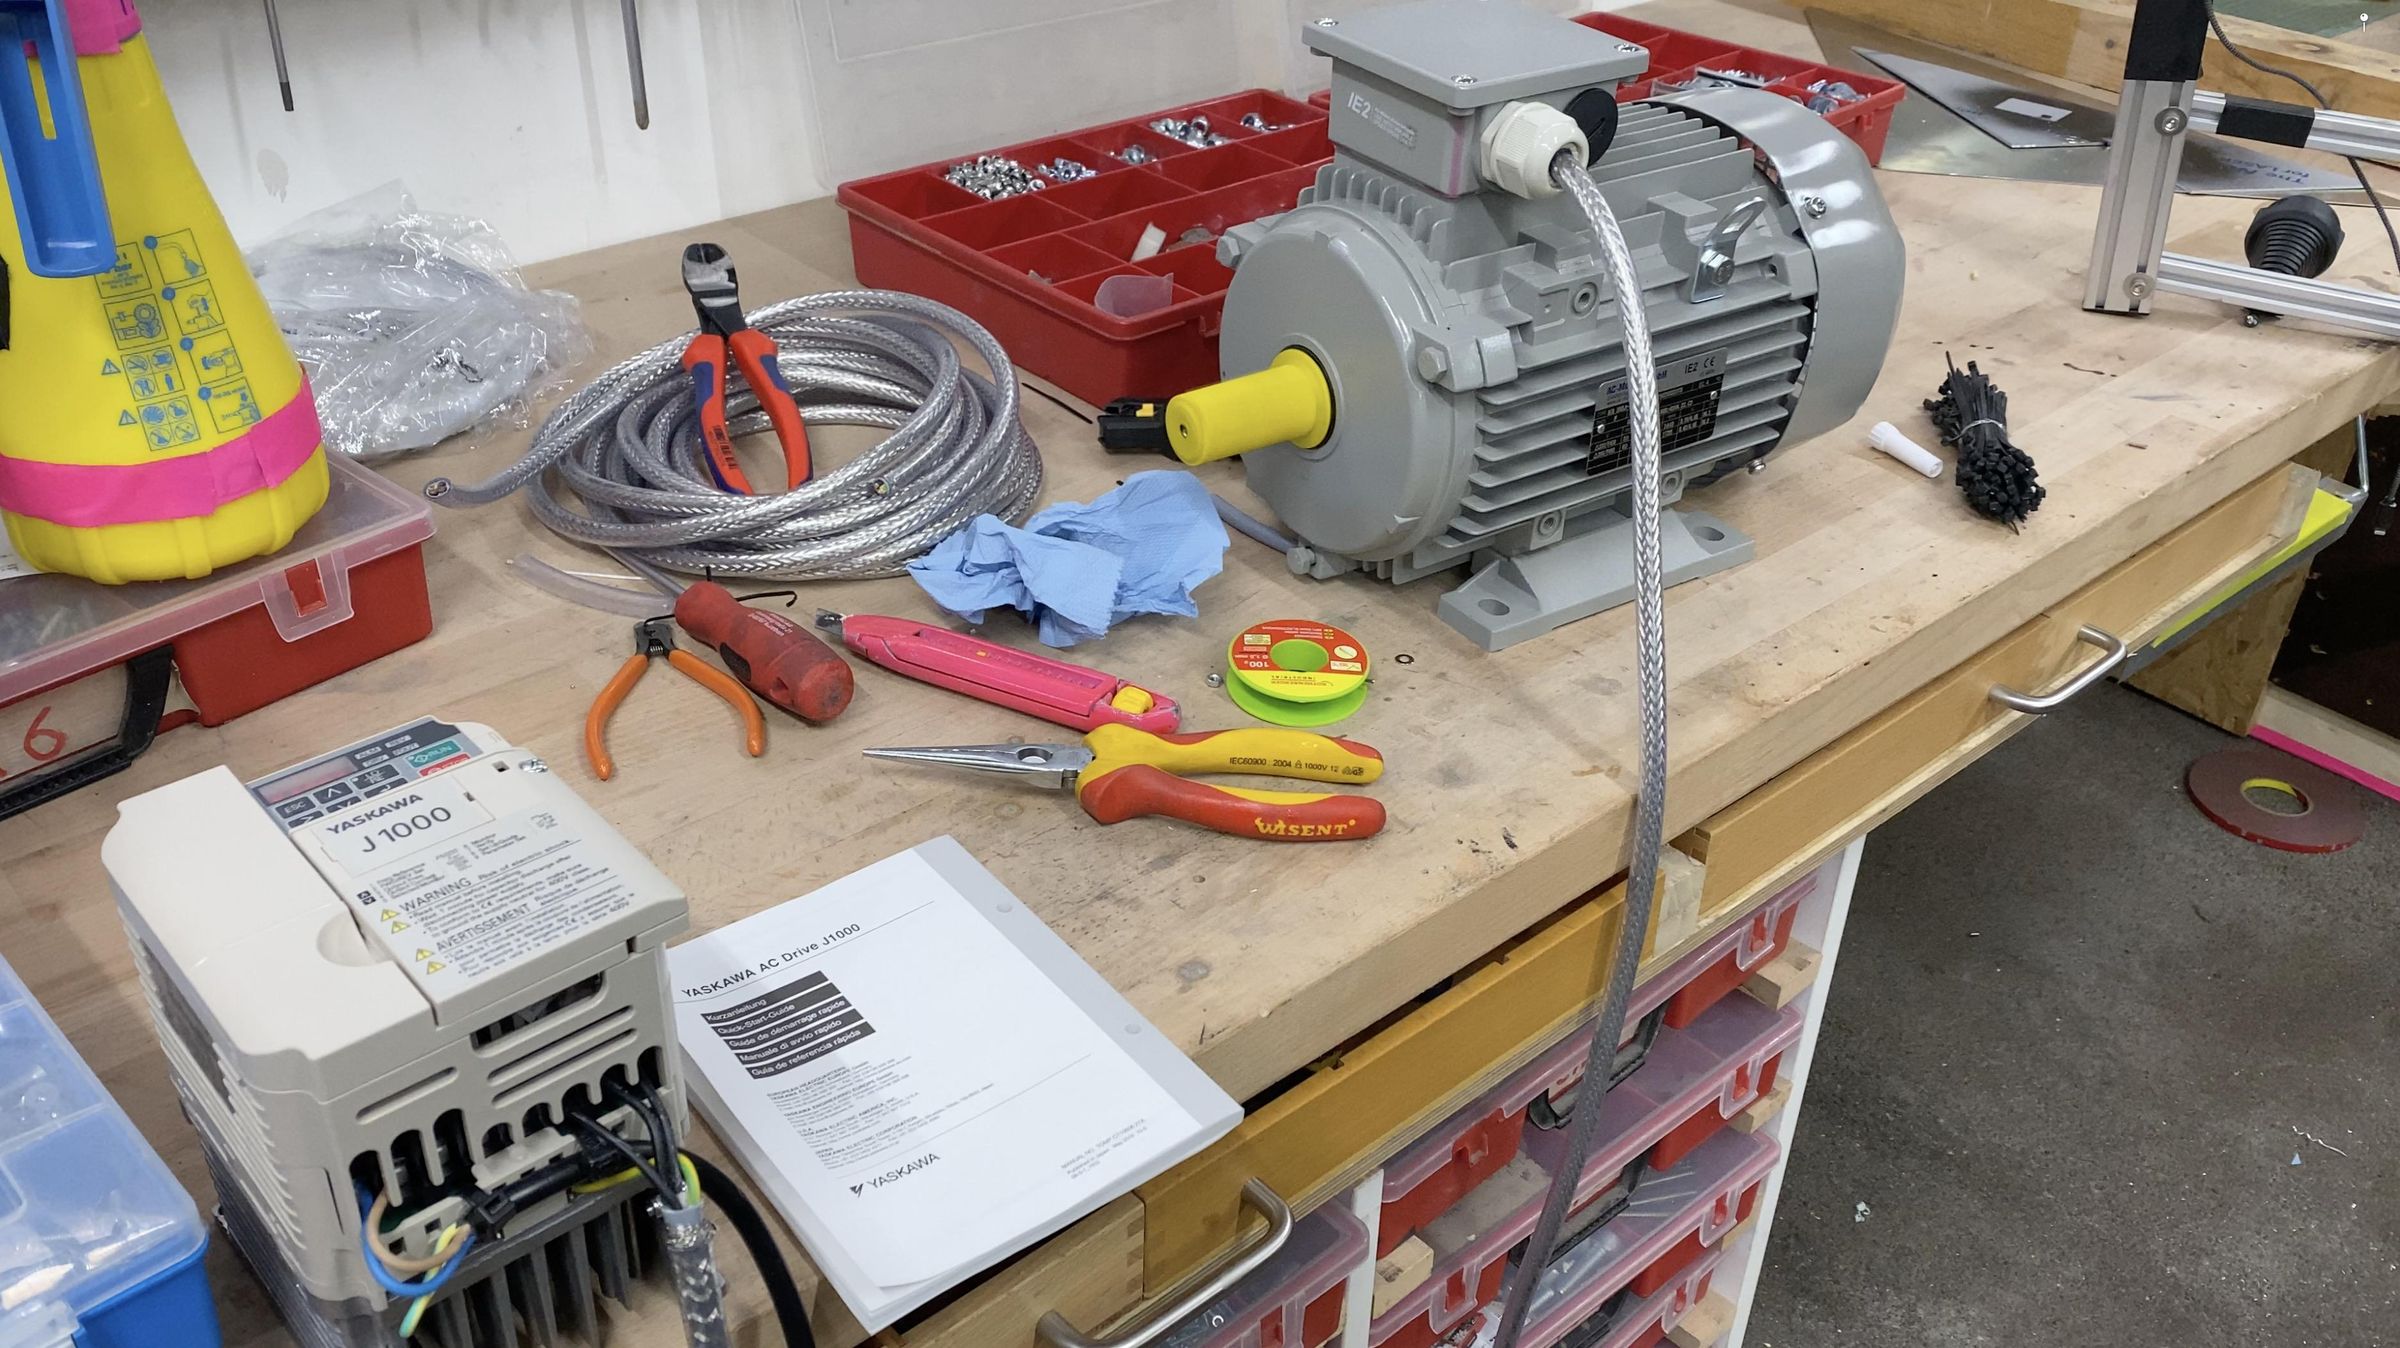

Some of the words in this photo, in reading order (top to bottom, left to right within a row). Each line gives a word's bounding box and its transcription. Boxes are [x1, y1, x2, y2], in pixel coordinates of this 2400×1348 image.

[1348, 92, 1371, 119] IE2
[1684, 362, 1699, 374] IE2
[1248, 660, 1269, 668] 100
[23, 705, 69, 762] 6
[427, 746, 453, 758] RUN
[1272, 759, 1292, 768] 2004
[1304, 762, 1328, 772] 1000V
[283, 801, 307, 814] ESC
[326, 794, 423, 835] YASKAWA
[398, 876, 473, 913] WARNING
[431, 902, 534, 951] AVERTISSEMENT
[681, 968, 756, 998] YASKAWA
[758, 957, 780, 973] AC
[781, 942, 819, 963] Drive
[822, 922, 861, 946] J1000
[705, 998, 768, 1022] Kurzanleitung
[716, 1003, 796, 1035] Quick-Start-Guide
[728, 1033, 757, 1048] Guide
[756, 1030, 770, 1041] de
[817, 999, 847, 1018] rapide
[739, 1043, 780, 1062] Manuale
[779, 1039, 789, 1050] di
[789, 1030, 814, 1046] avvio
[813, 1018, 843, 1036] rapido
[775, 1059, 789, 1070] de
[788, 1040, 834, 1066] referencia
[866, 1153, 941, 1190] YASKAWA
